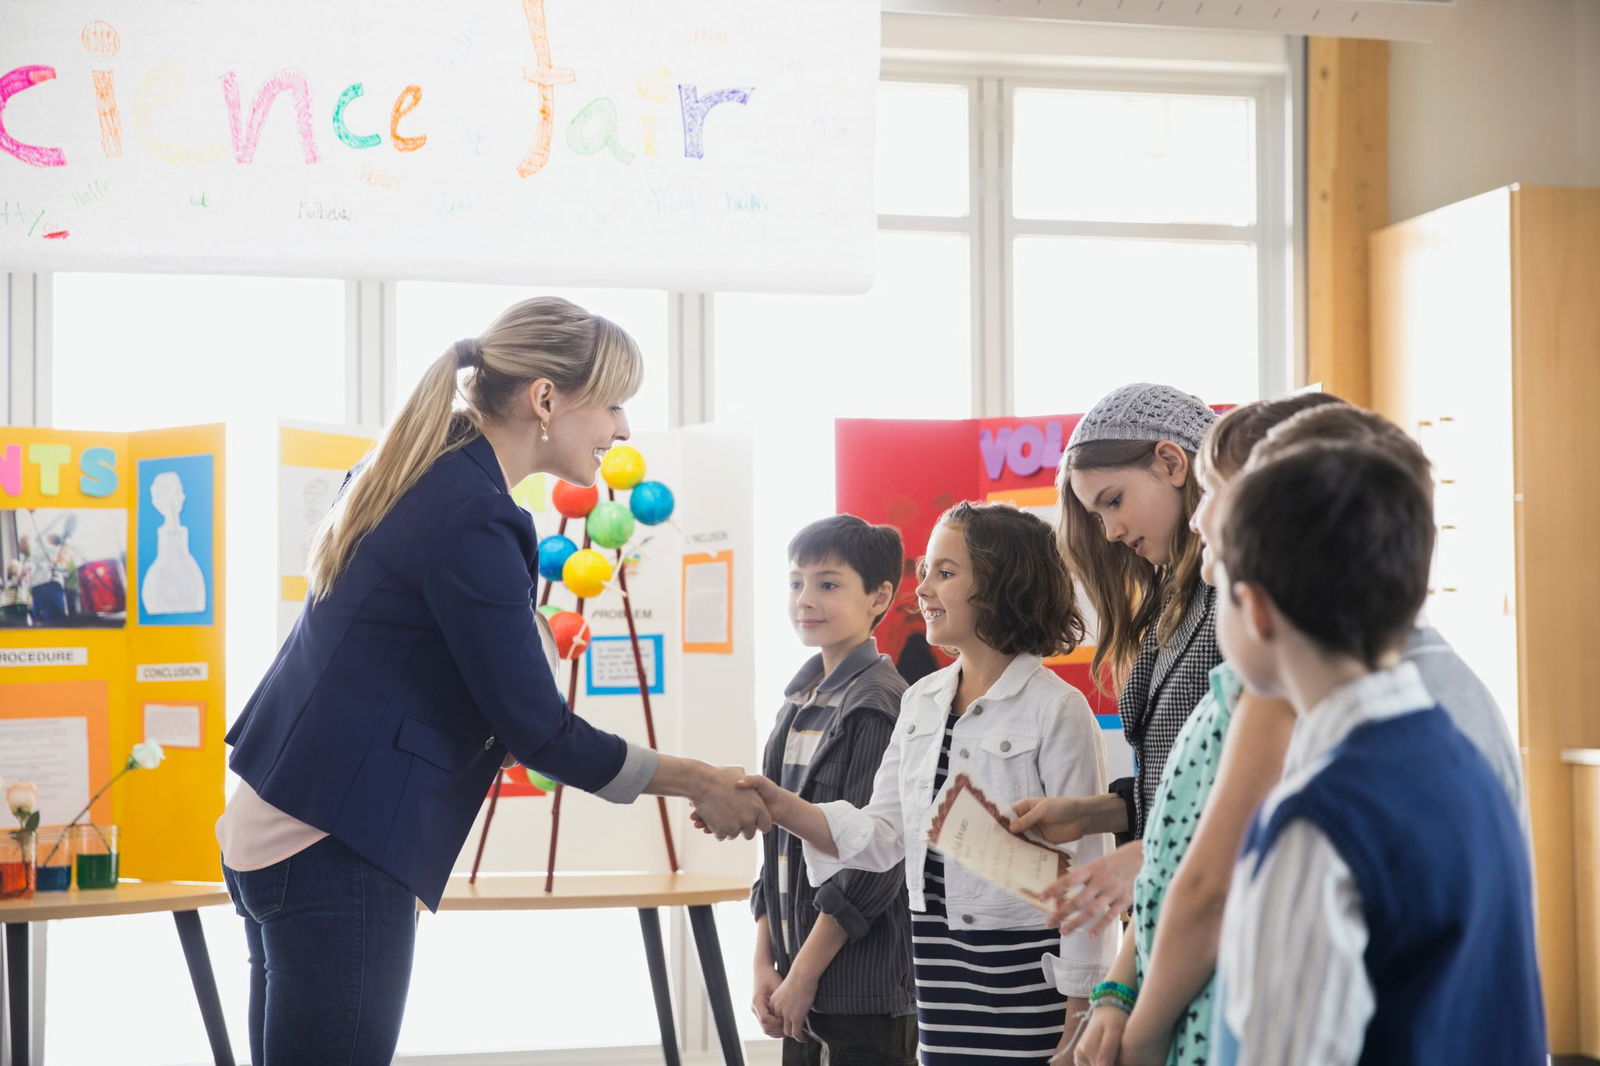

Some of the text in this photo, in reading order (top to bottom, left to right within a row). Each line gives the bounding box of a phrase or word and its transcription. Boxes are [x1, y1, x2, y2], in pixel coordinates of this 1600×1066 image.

[0, 20, 428, 167] cience
[591, 608, 652, 620] PROBEM
[143, 667, 202, 679] CONCLUSION
